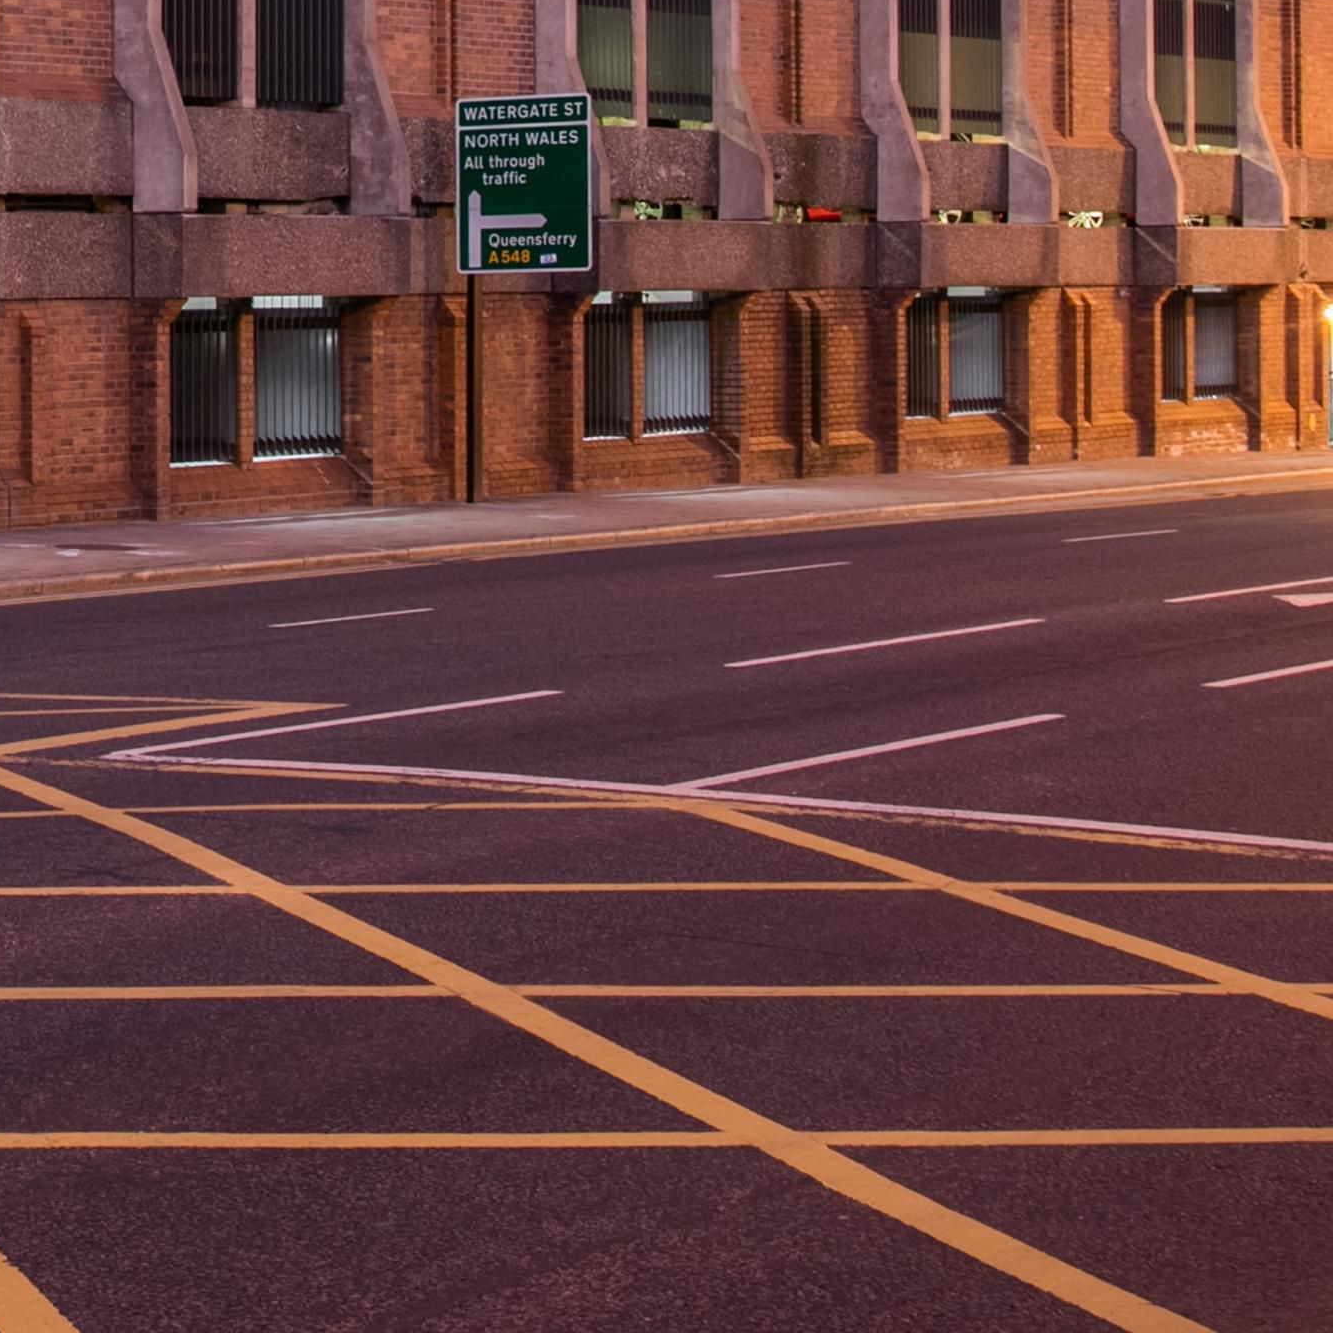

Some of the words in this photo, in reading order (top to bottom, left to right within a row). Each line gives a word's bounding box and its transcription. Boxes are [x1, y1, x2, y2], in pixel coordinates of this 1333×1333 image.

[463, 103, 558, 120] WATERGATE
[564, 101, 583, 116] ST
[464, 133, 519, 148] NORTH
[525, 130, 579, 145] WALES
[464, 156, 484, 170] All
[488, 153, 545, 169] through
[482, 171, 527, 185] traffic
[488, 233, 577, 247] Queensferry
